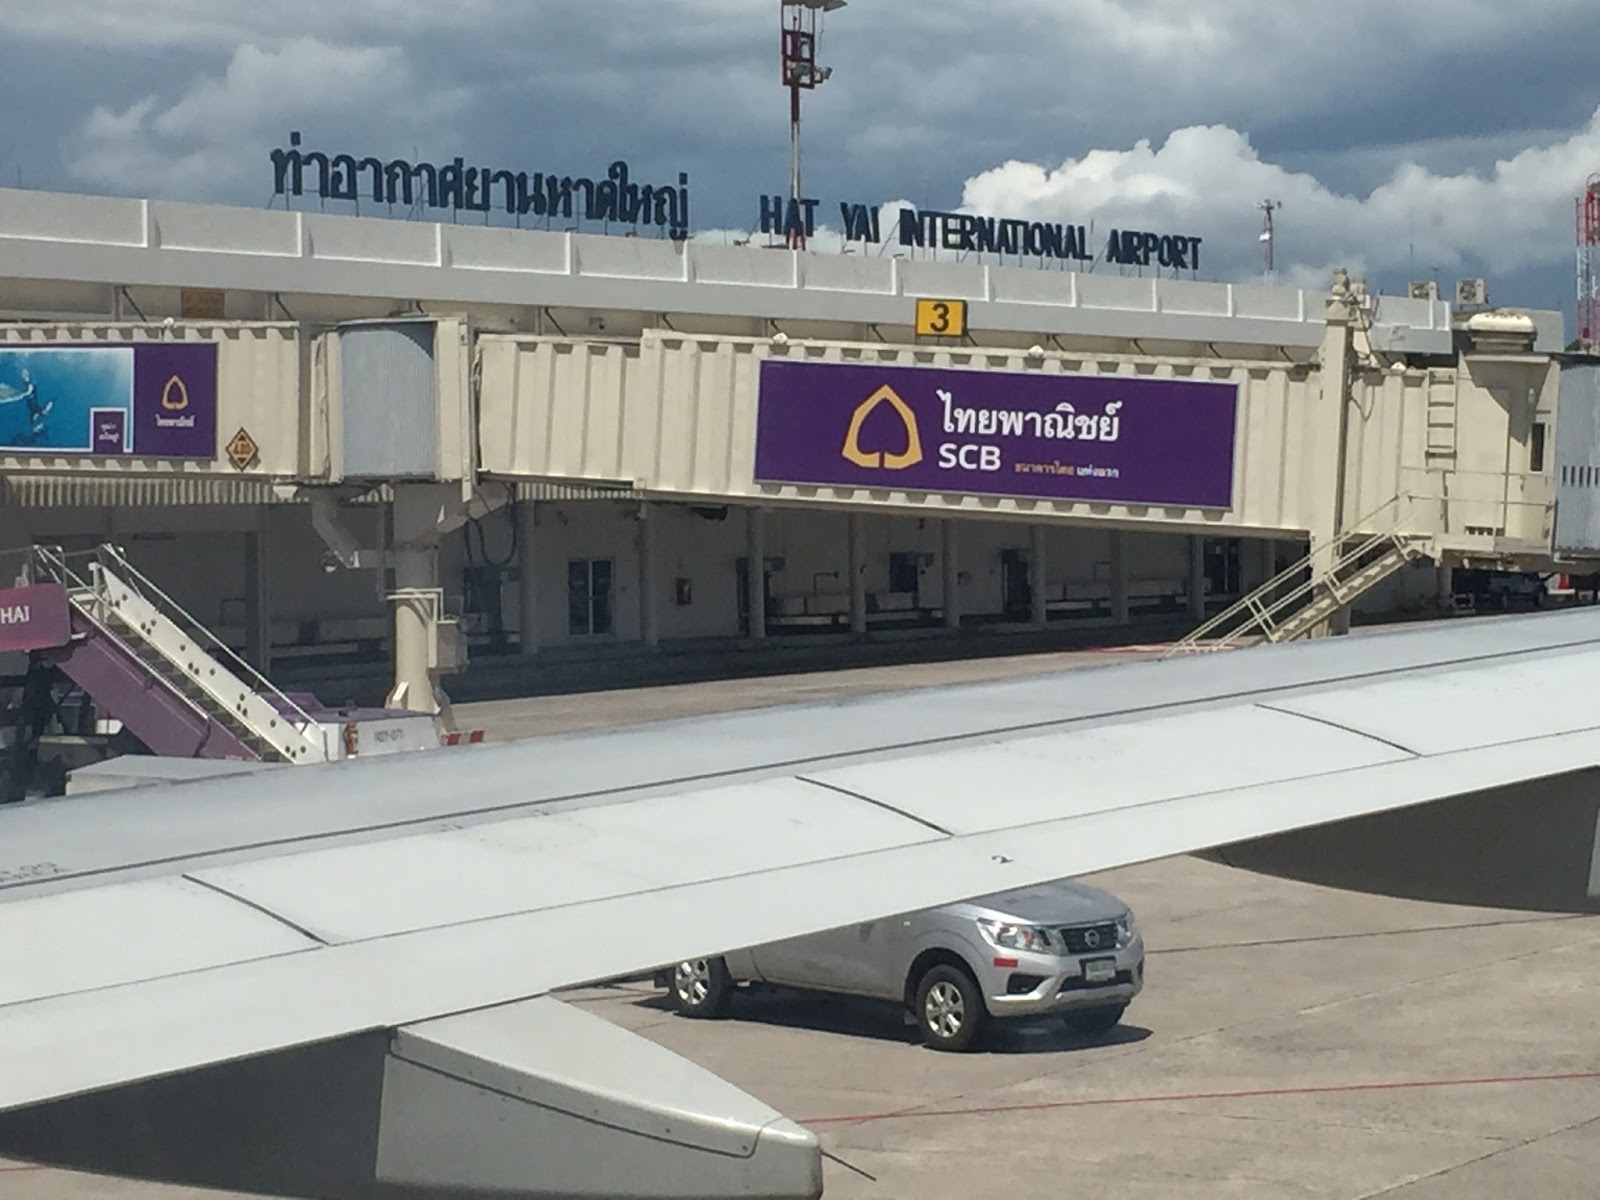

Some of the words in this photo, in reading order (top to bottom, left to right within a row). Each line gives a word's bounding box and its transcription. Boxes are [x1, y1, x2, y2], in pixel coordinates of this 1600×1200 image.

[270, 131, 690, 240] ท่าอากาศยานหาดใหญ่
[759, 194, 820, 243] HAT
[839, 201, 880, 243] YAI
[899, 208, 1093, 261] INTERNATIONAL
[1106, 228, 1203, 270] AIRPORT
[929, 303, 951, 333] 3
[936, 389, 1123, 442] ไทยพาณิชย์
[938, 443, 1002, 471] SCB
